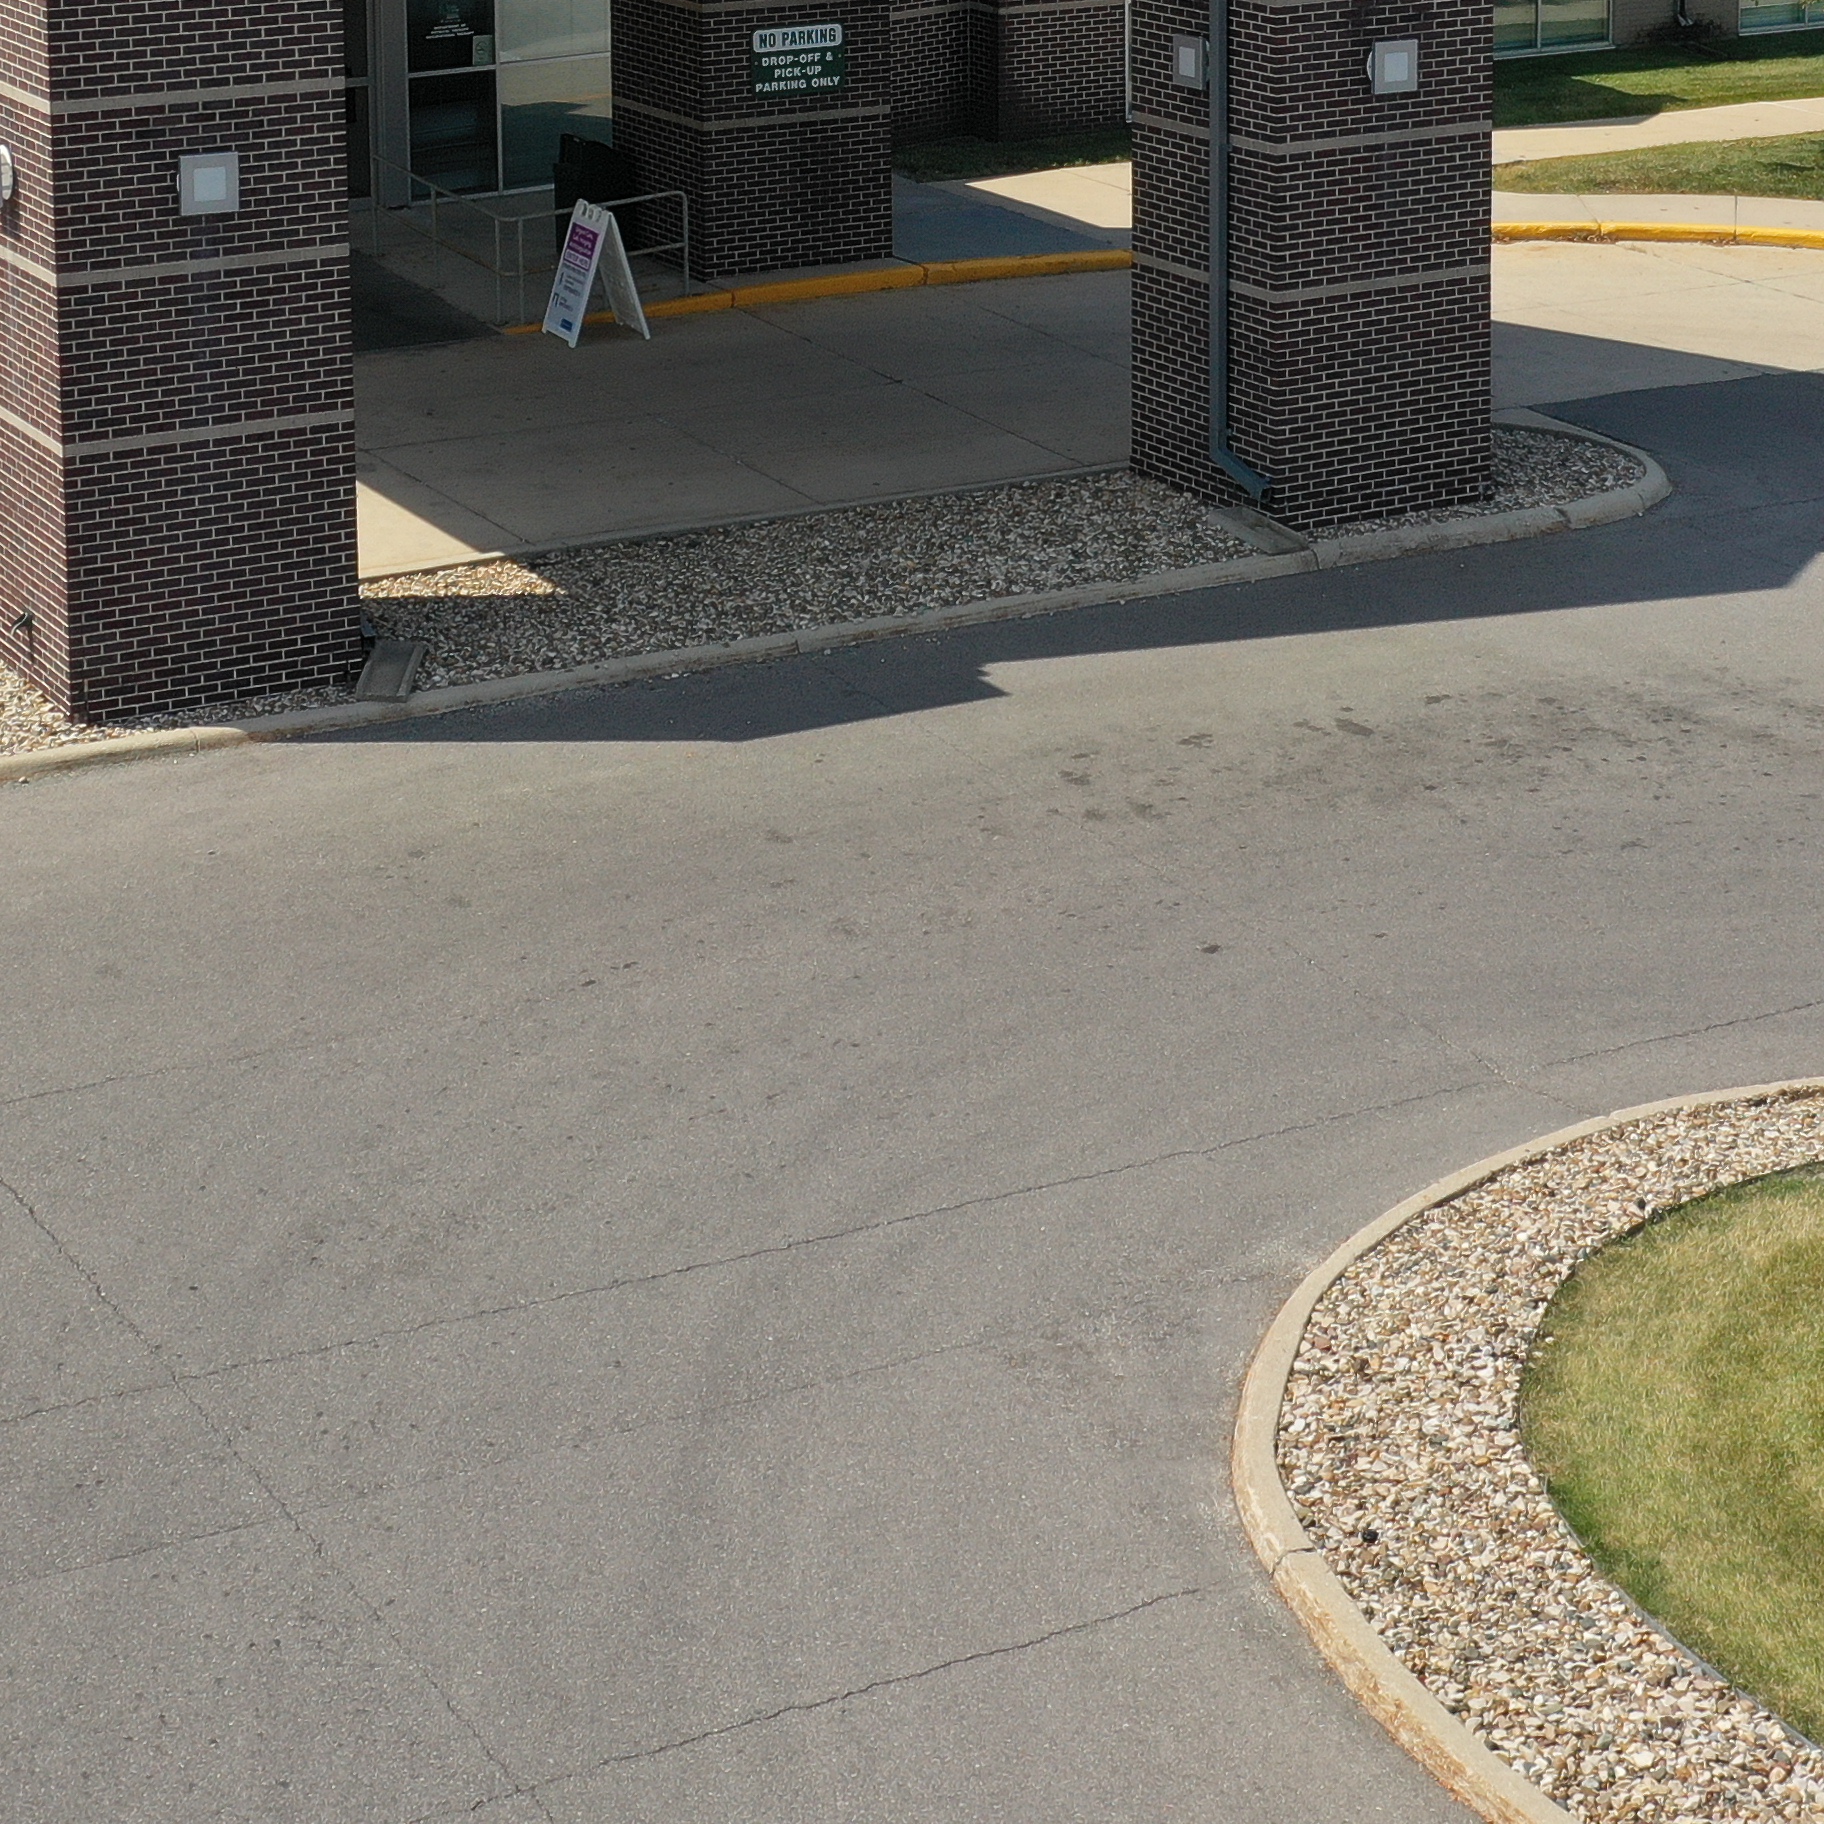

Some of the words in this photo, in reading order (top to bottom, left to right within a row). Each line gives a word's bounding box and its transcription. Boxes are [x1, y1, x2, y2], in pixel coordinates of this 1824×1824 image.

[758, 32, 776, 49] NO
[781, 27, 837, 47] PARKING
[761, 52, 821, 67] DROP-OFF
[825, 51, 833, 61] &
[774, 65, 822, 79] PICK-UP
[755, 79, 807, 93] PARKING
[811, 76, 840, 88] ONLY
